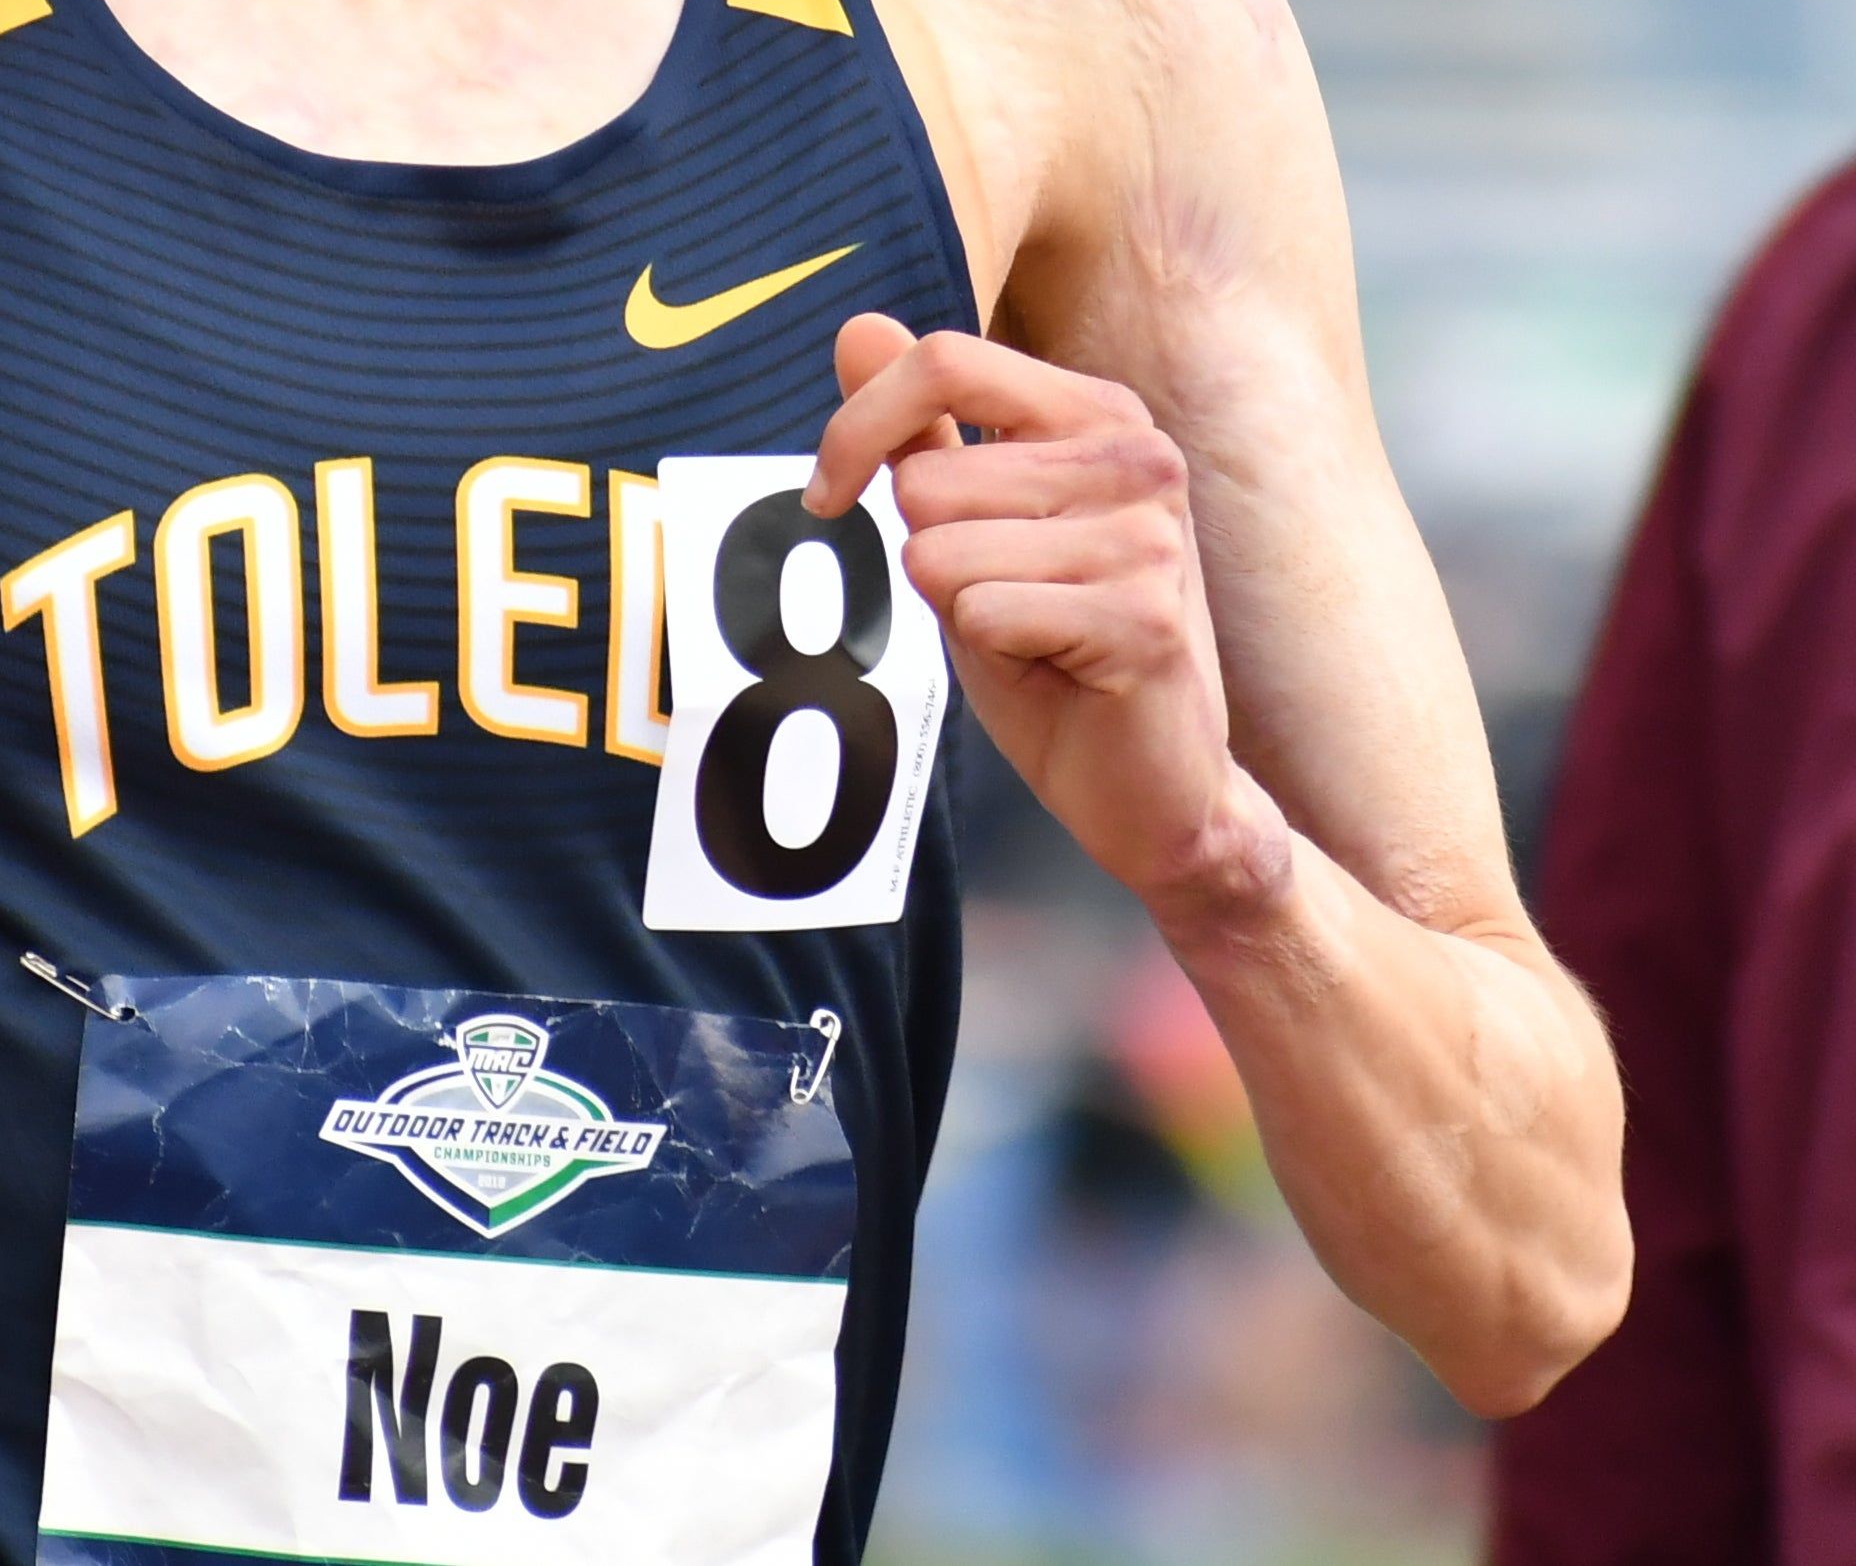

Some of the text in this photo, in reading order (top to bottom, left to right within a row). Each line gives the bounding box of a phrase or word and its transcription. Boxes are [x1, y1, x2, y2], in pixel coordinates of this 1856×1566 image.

[695, 487, 899, 901] 8
[469, 1048, 533, 1074] MAC
[332, 1108, 653, 1156] OUTDOOR TRACK & FIELD
[433, 1146, 552, 1168] CHAMPIONSHIPS
[338, 1309, 600, 1520] Noe
